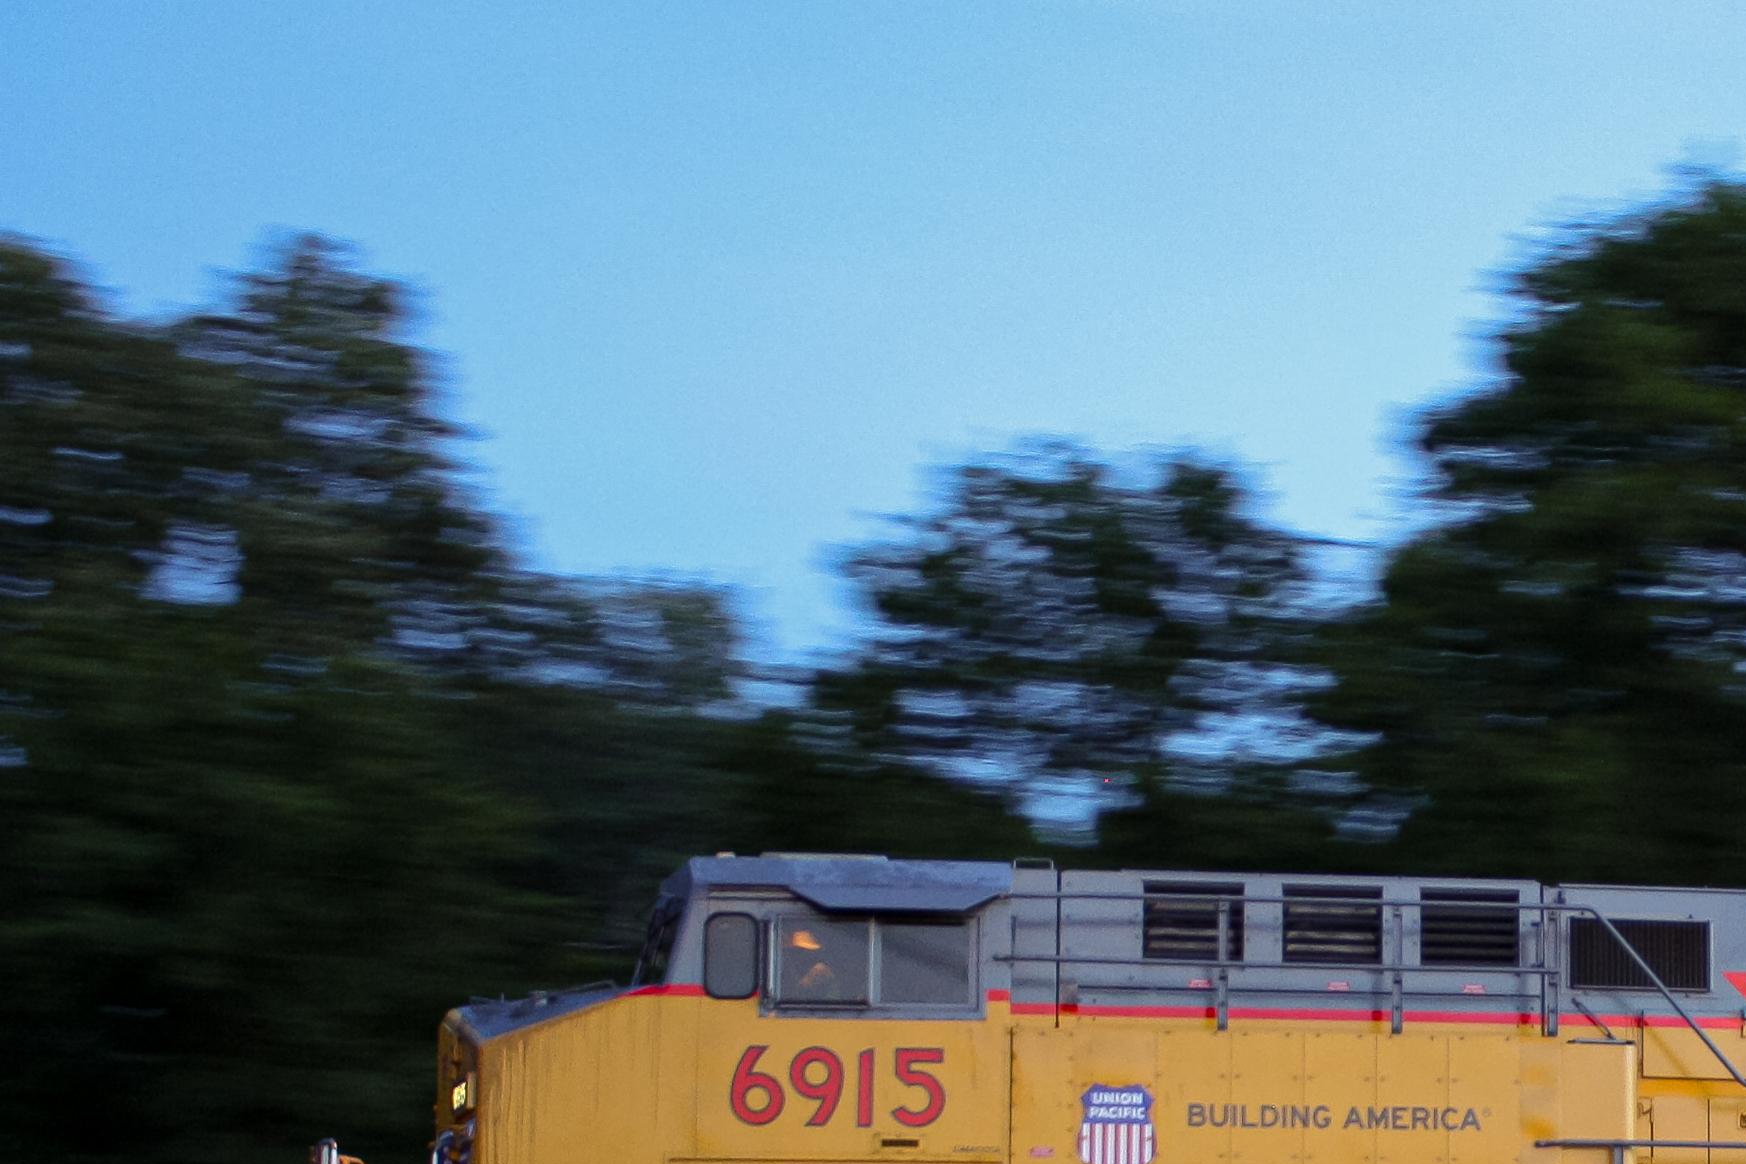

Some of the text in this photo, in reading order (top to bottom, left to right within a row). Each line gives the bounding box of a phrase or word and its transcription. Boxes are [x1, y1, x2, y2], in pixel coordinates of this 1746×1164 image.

[730, 1045, 946, 1128] 6915
[1092, 1091, 1144, 1105] UNION
[1088, 1106, 1146, 1120] PACIFIC
[1187, 1103, 1482, 1131] BUILDING AMERICA
